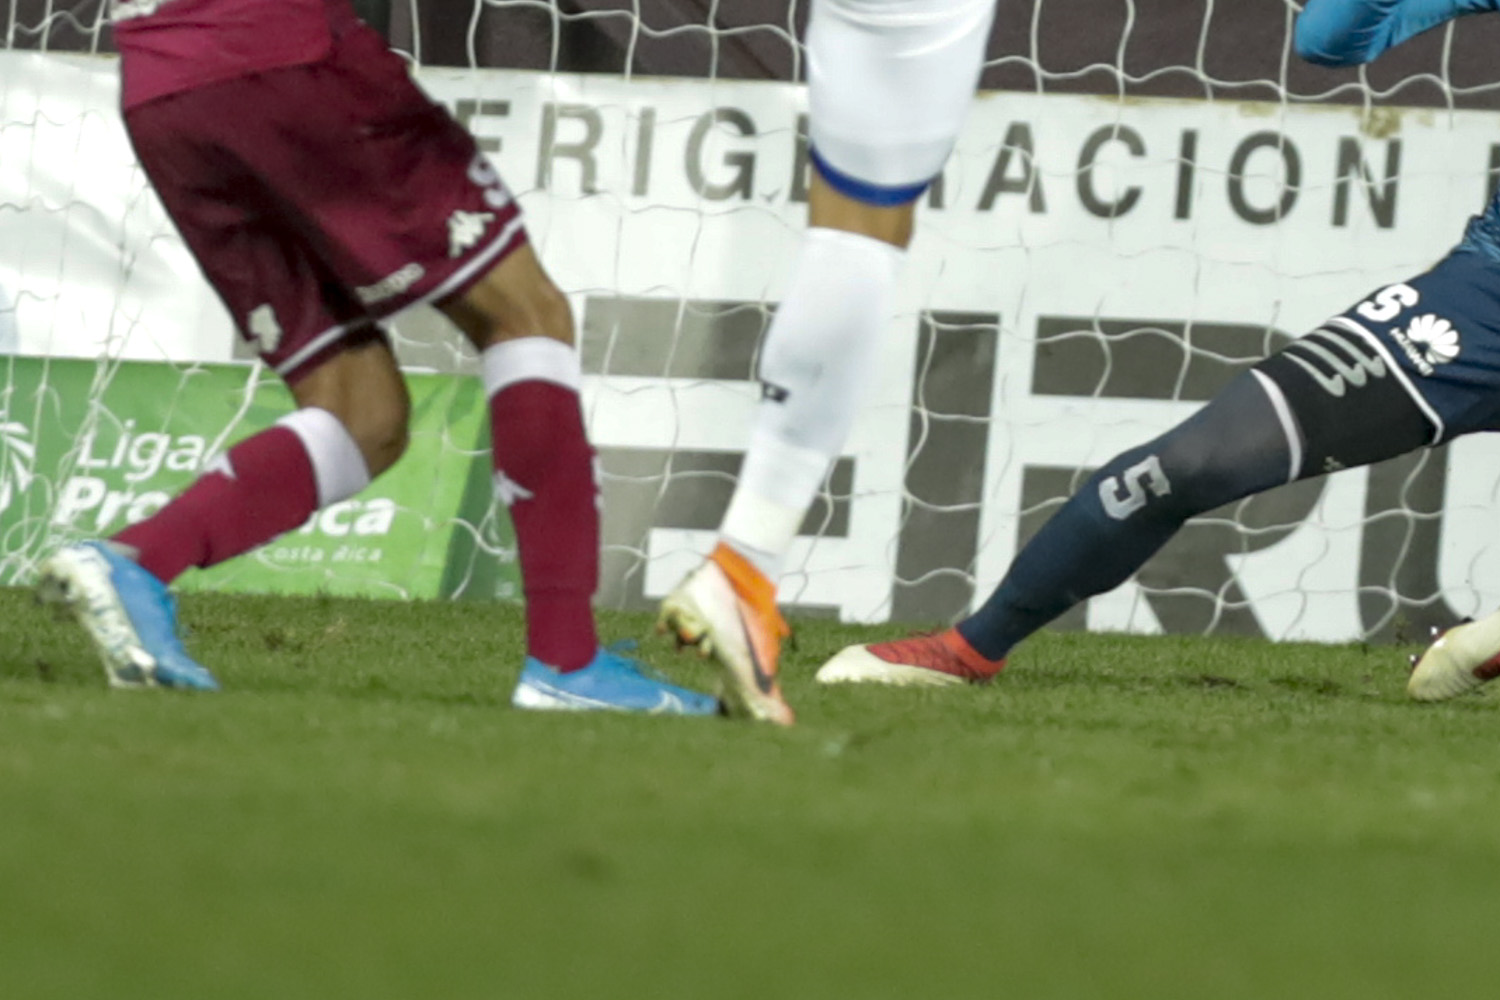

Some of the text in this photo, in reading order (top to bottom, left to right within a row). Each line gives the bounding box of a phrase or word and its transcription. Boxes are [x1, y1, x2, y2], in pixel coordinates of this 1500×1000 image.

[1356, 282, 1419, 322] S
[76, 419, 206, 483] Liga
[1098, 454, 1173, 521] S
[333, 543, 384, 563] Rica
